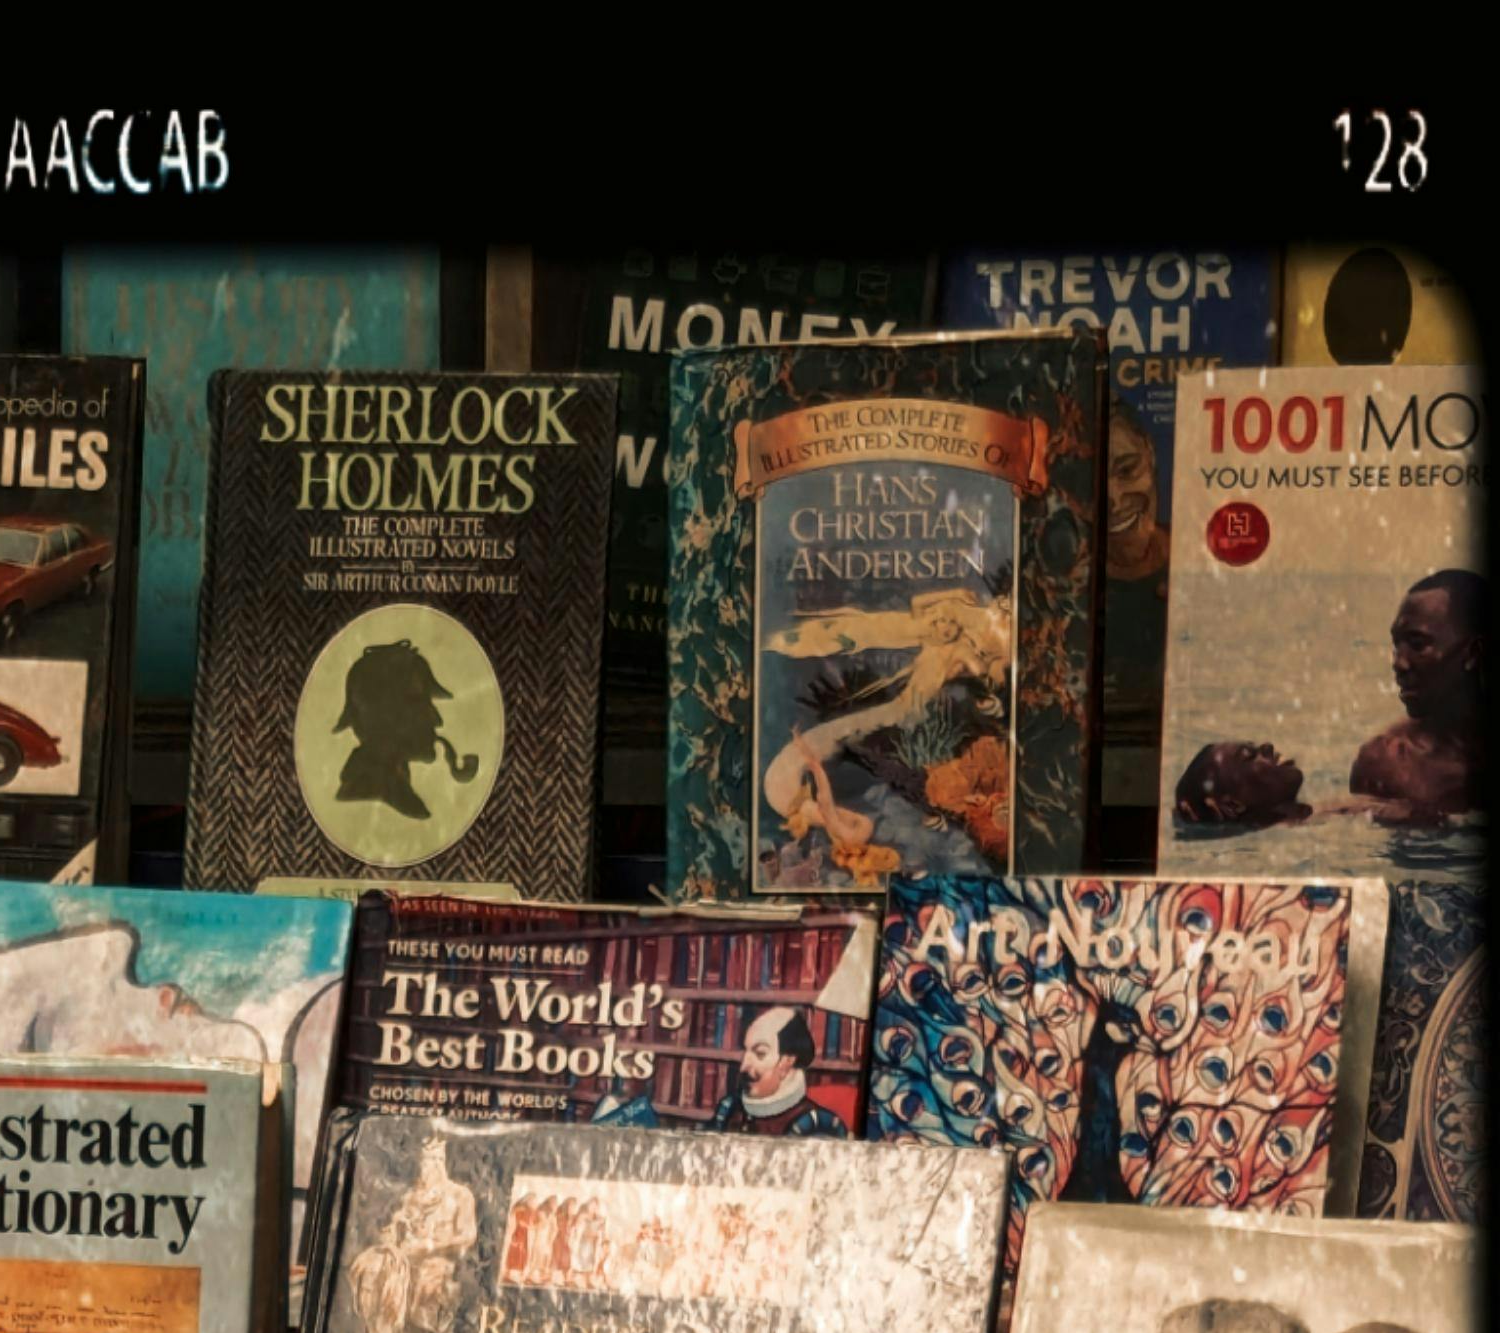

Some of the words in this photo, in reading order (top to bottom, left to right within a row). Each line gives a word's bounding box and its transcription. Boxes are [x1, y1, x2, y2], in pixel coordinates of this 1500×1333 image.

[977, 251, 1233, 309] TREVOR
[84, 386, 110, 419] of
[260, 383, 579, 448] SHERLOCK
[808, 409, 851, 434] THE
[857, 405, 965, 434] COMPLETE
[1203, 394, 1346, 454] 1001
[1361, 391, 1485, 452] MO
[759, 431, 892, 473] ILLUSTRATED
[896, 429, 979, 459] STORIES
[984, 443, 1012, 470] OF
[296, 451, 537, 515] HOLMES
[832, 470, 939, 508] HANS
[1201, 467, 1259, 491] YOU
[1268, 466, 1341, 490] MUST
[1349, 465, 1390, 488] SEE
[344, 516, 380, 538] THE
[383, 517, 485, 539] COMPLETE
[788, 506, 985, 545] CHRISTIAN
[309, 537, 436, 559] ILLUSTRATED
[440, 537, 516, 561] NOVELS
[786, 547, 986, 583] ANDERSEN
[302, 573, 329, 593] SIR
[333, 573, 399, 594] ARTHUR
[401, 573, 462, 595] CONAN
[466, 574, 519, 596] DOYLE
[423, 899, 458, 914] SEEN
[912, 904, 1016, 963] Art
[387, 940, 440, 960] THESE
[444, 942, 484, 962] YOU
[488, 944, 537, 964] MUST
[541, 946, 590, 967] READ
[381, 969, 480, 1020] The
[490, 976, 685, 1031] World's
[374, 1020, 485, 1072] Best
[495, 1028, 655, 1080] Books
[369, 1085, 436, 1103] CHOSEN
[438, 1088, 460, 1104] BY
[463, 1089, 490, 1107] THE
[496, 1091, 568, 1111] WORLD'S
